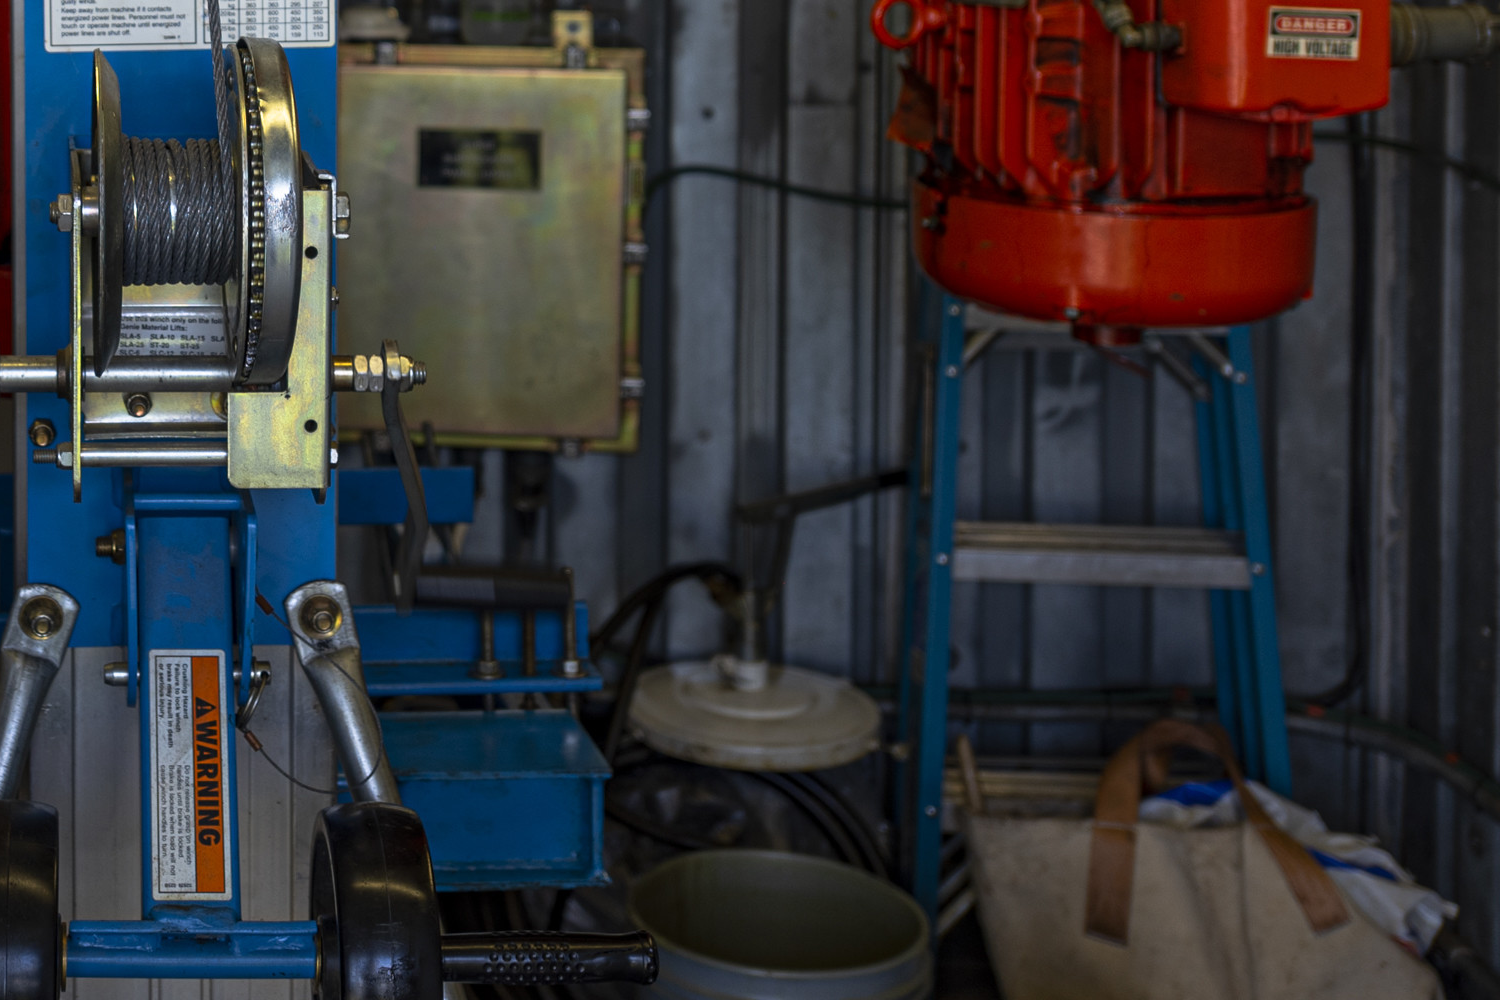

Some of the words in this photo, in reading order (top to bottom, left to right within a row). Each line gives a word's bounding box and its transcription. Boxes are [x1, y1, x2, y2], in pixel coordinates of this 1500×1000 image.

[1280, 18, 1348, 30] DANGER
[1273, 39, 1300, 53] HIGH
[1305, 41, 1352, 56] VOLTAGE
[159, 663, 164, 671] or
[167, 720, 173, 728] in
[184, 764, 190, 772] Do
[196, 720, 220, 846] WARNING
[161, 834, 167, 842] to
